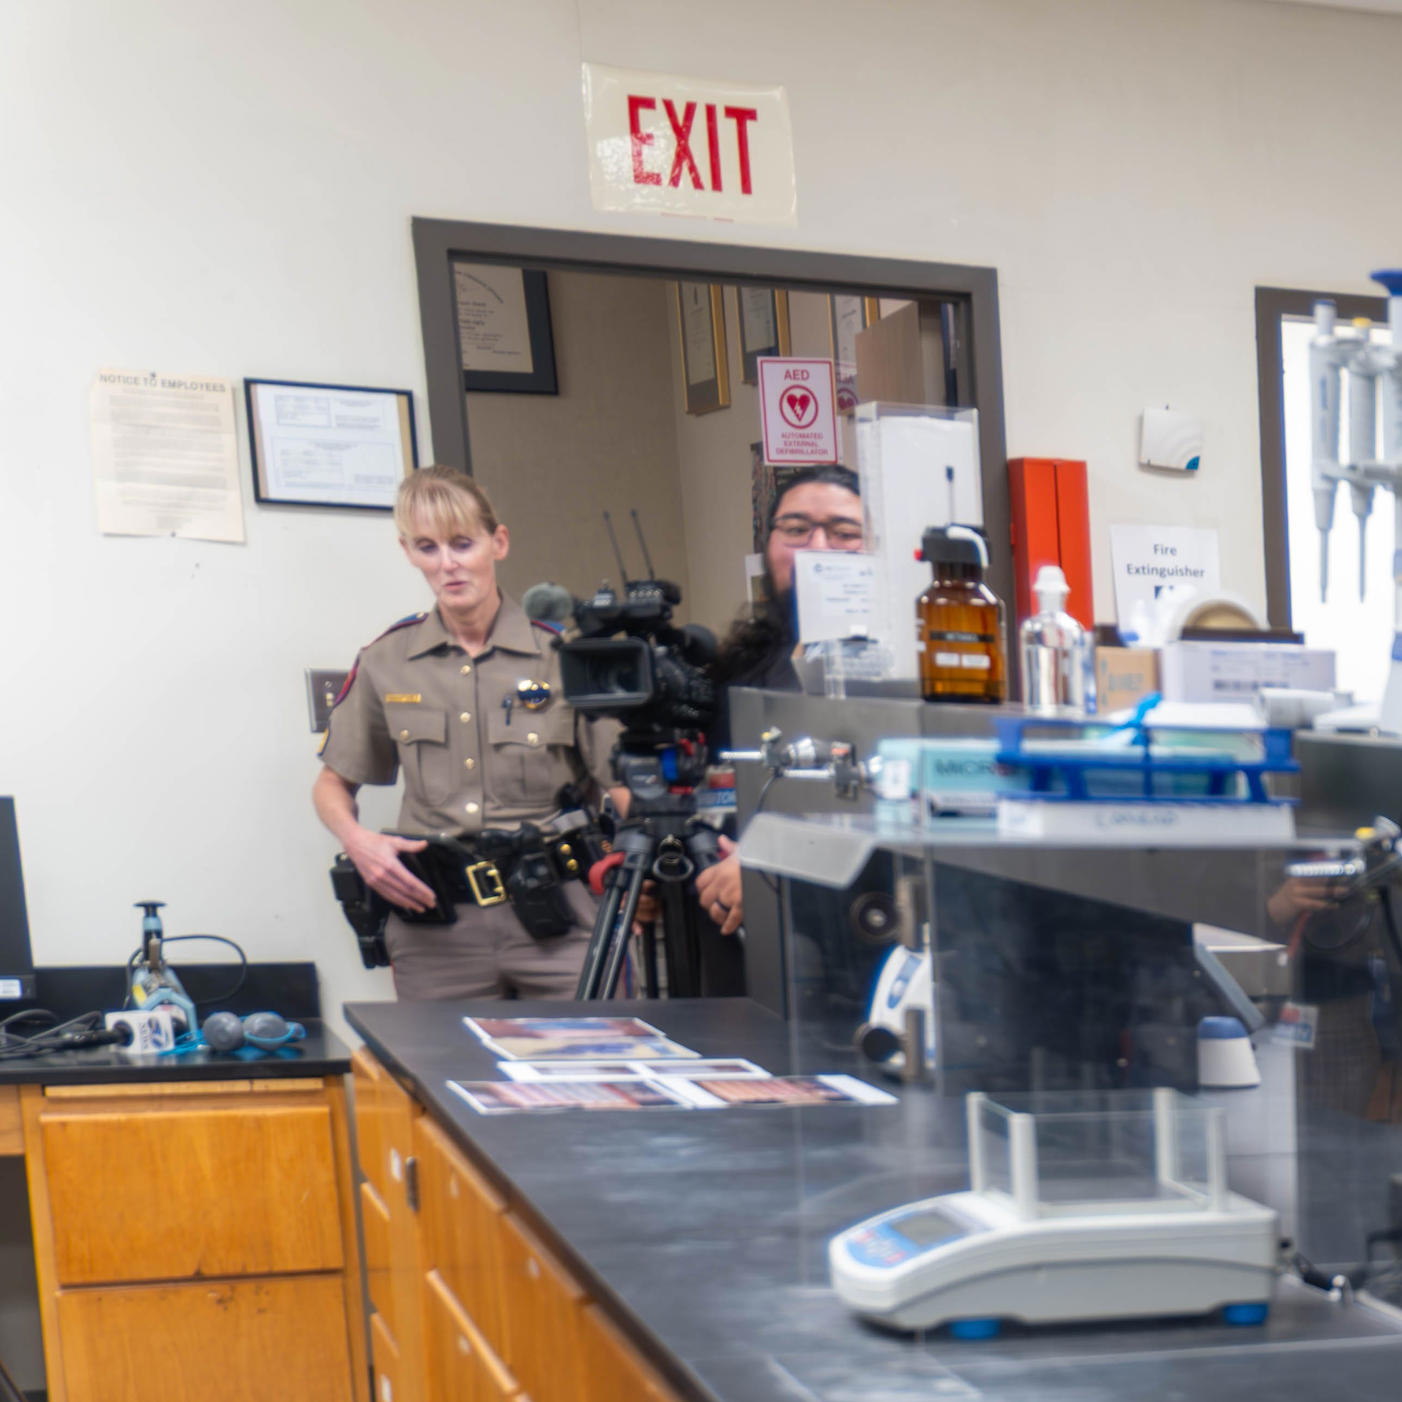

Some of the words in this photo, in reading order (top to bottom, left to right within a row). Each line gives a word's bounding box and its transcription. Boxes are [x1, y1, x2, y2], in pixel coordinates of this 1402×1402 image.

[627, 94, 758, 195] EXIT
[783, 368, 811, 381] AED
[99, 373, 141, 385] NOTICE
[160, 379, 227, 393] EMPLOYEES
[780, 431, 824, 440] AUTOMATED
[783, 440, 819, 448] EXTERNAL
[1152, 543, 1178, 557] Fire
[1126, 562, 1206, 579] Extinguisher
